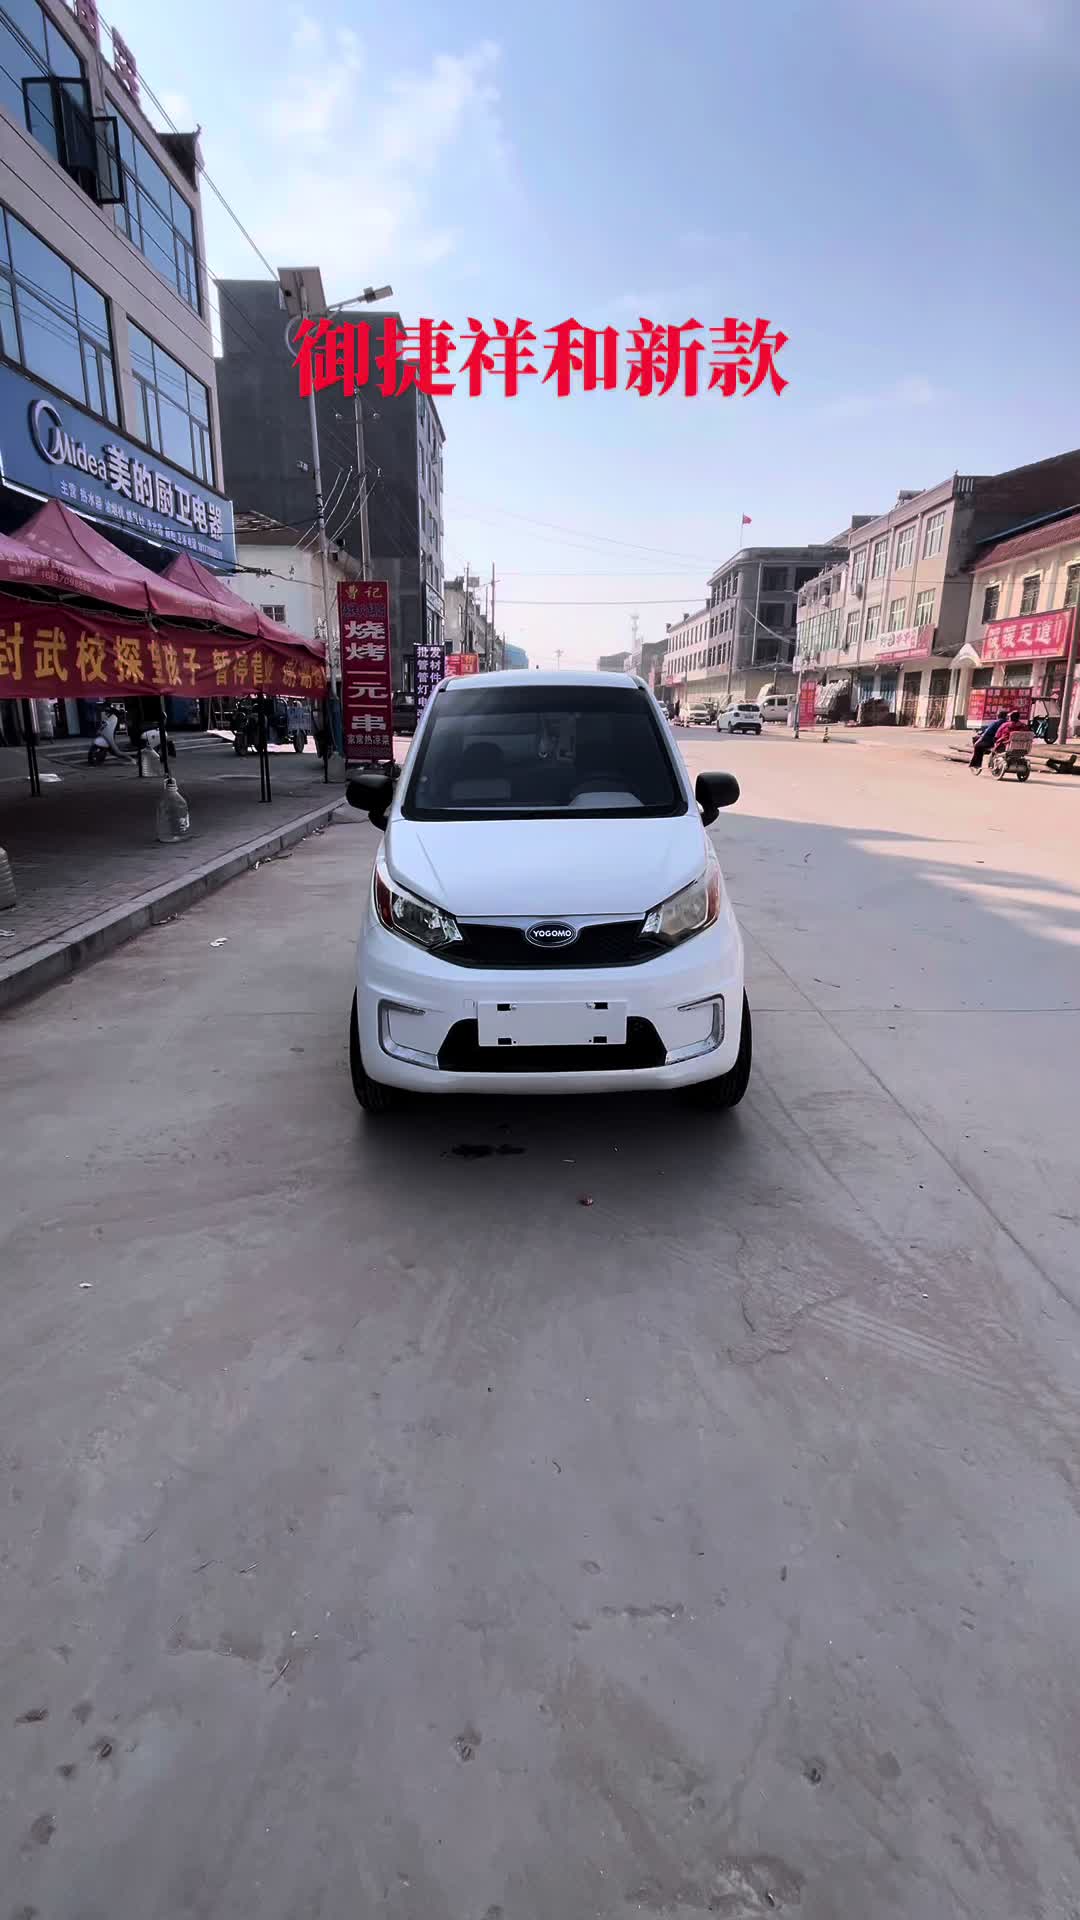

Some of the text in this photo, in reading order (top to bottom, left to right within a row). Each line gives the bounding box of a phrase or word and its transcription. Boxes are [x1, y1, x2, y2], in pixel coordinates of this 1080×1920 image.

[44, 418, 108, 481] Midea
[107, 443, 223, 541] 美的厨卫电器
[532, 929, 572, 938] YOGOMO
